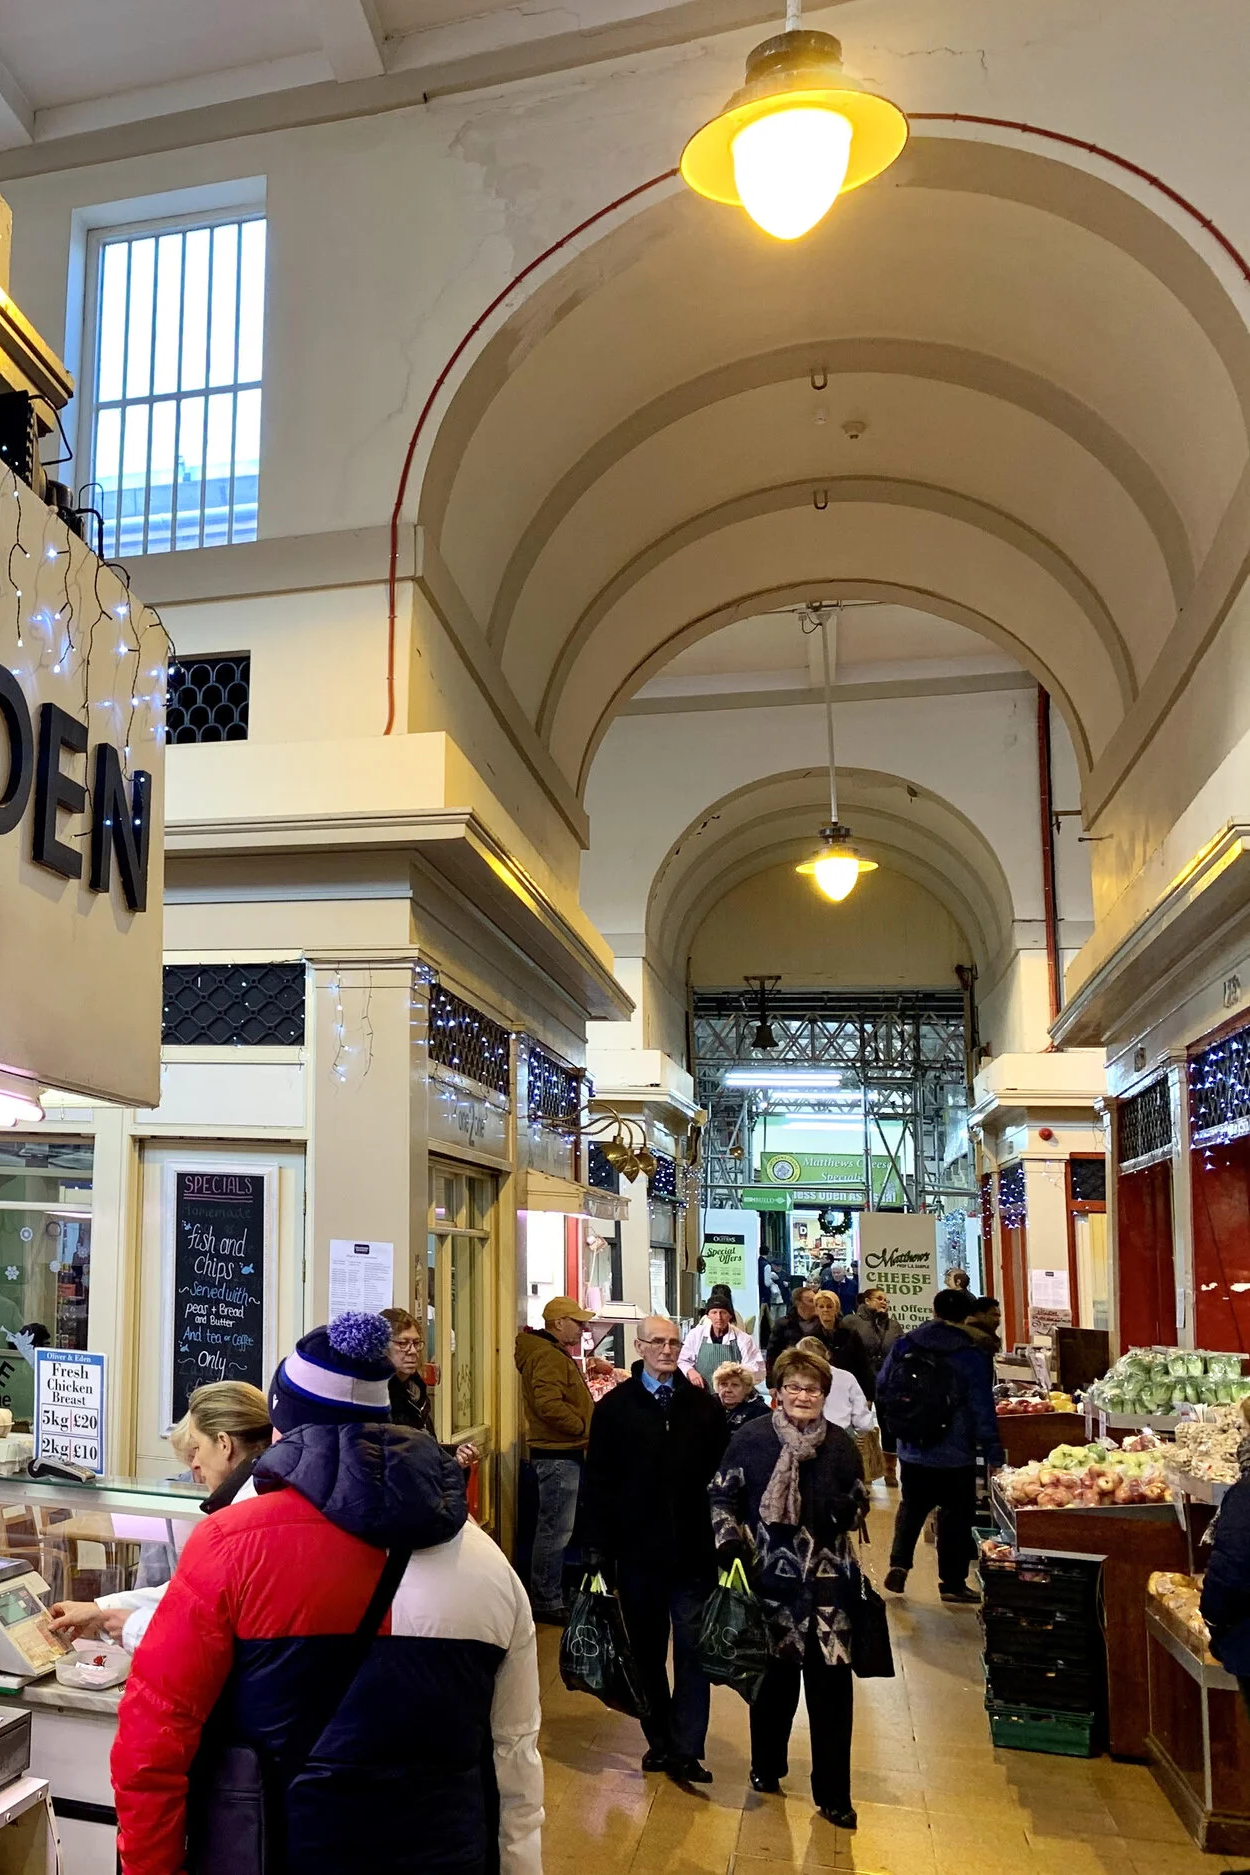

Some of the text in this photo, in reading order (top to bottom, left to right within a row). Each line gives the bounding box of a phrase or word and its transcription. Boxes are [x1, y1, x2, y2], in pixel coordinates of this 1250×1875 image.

[803, 1157, 854, 1168] Matthews
[184, 1175, 253, 1194] SPECIALS
[188, 1223, 248, 1257] fish and
[707, 1247, 736, 1258] Special
[719, 1254, 742, 1264] Offers
[866, 1272, 931, 1284] CHEESE
[876, 1284, 923, 1296] SHOP
[184, 1303, 208, 1318] peas
[219, 1303, 244, 1318] Bread
[901, 1304, 934, 1314] Offers
[194, 1315, 236, 1328] and Butter
[183, 1326, 202, 1341] And
[206, 1329, 222, 1344] tea
[46, 1352, 66, 1361] Oliver
[74, 1354, 92, 1363] Eden
[52, 1362, 90, 1380] Fresh
[198, 1350, 226, 1381] Only
[47, 1378, 94, 1395] Chicken
[52, 1392, 86, 1406] Breast
[42, 1410, 98, 1432] 5kg £20
[42, 1438, 98, 1460] 2kg £10
